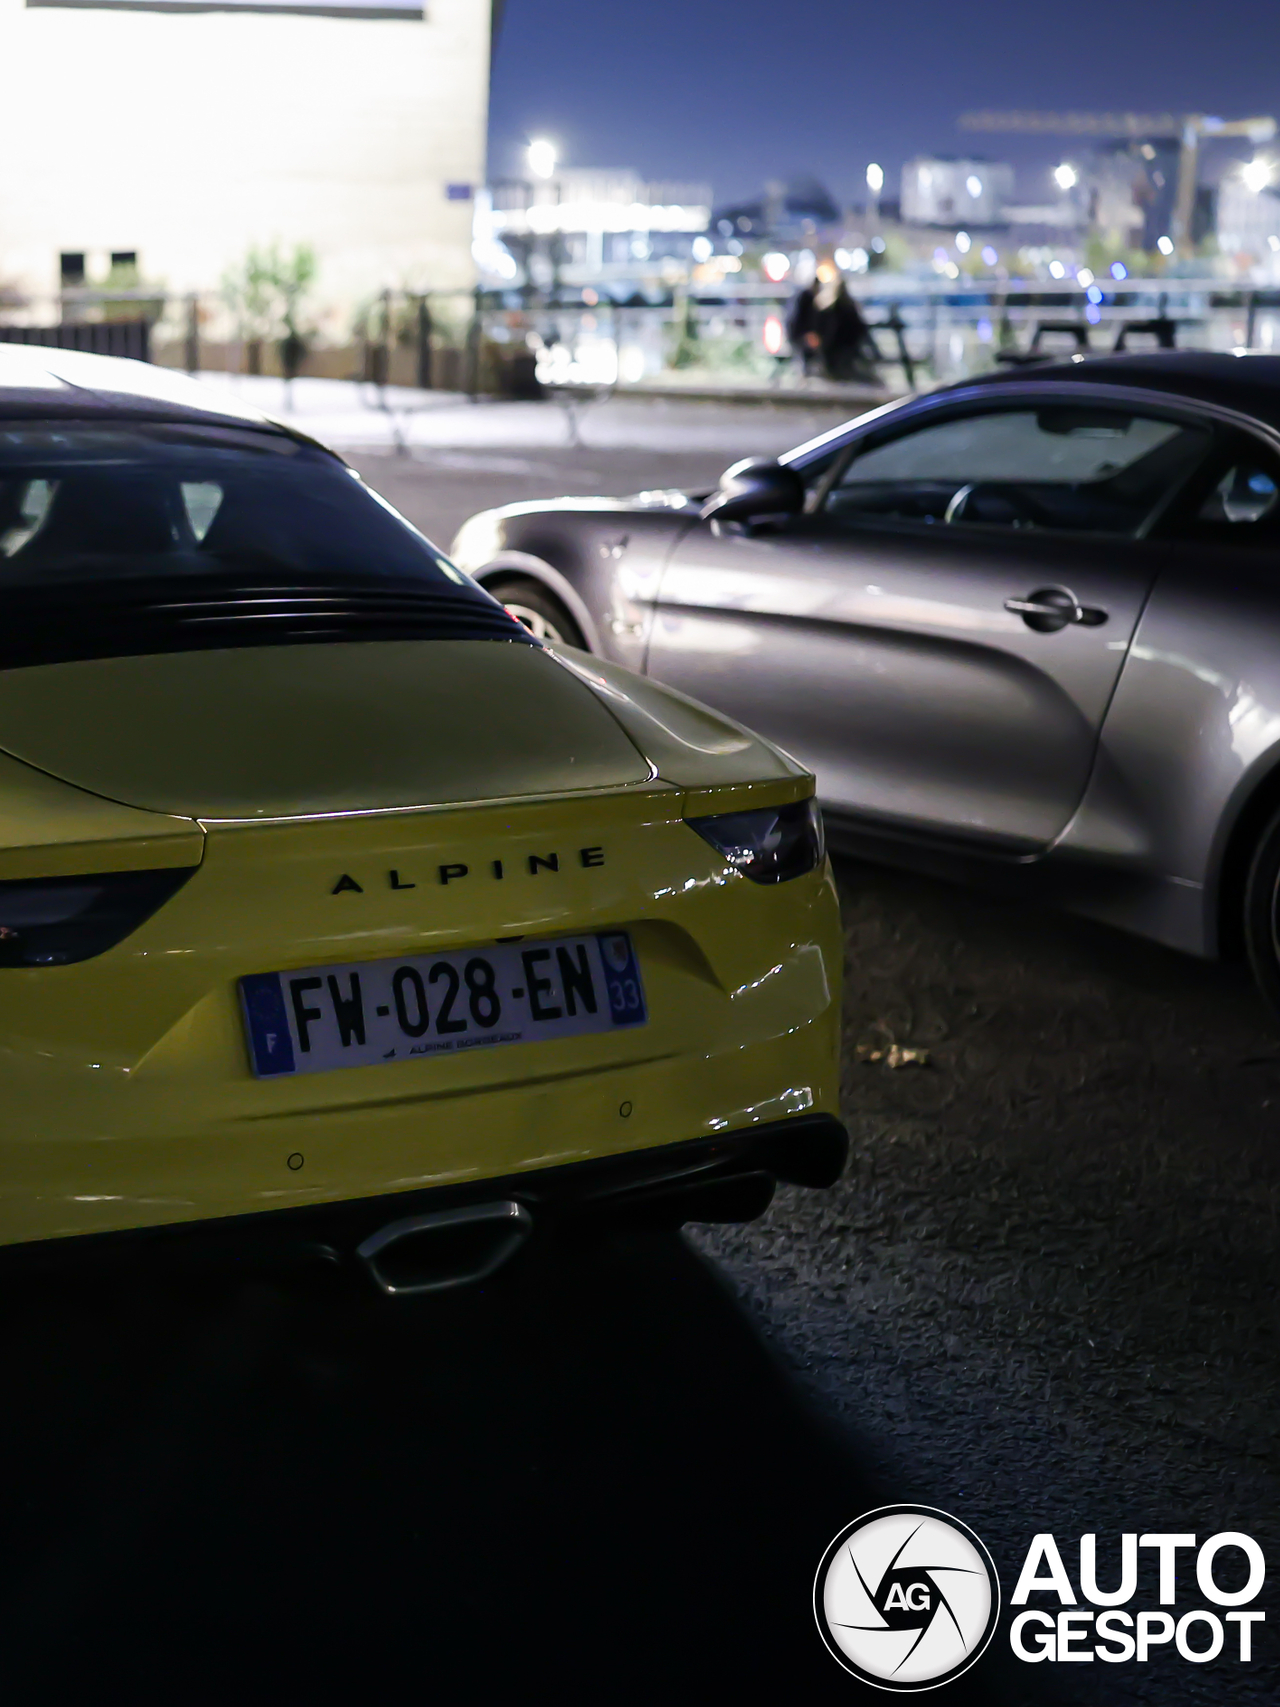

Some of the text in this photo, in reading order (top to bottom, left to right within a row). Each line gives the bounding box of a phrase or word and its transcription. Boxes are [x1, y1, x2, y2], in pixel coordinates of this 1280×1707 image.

[331, 846, 605, 896] ALPINE
[289, 943, 599, 1055] FW-028-EN
[609, 978, 640, 1011] 33
[265, 1033, 277, 1053] F
[410, 1041, 453, 1054] ALPINE
